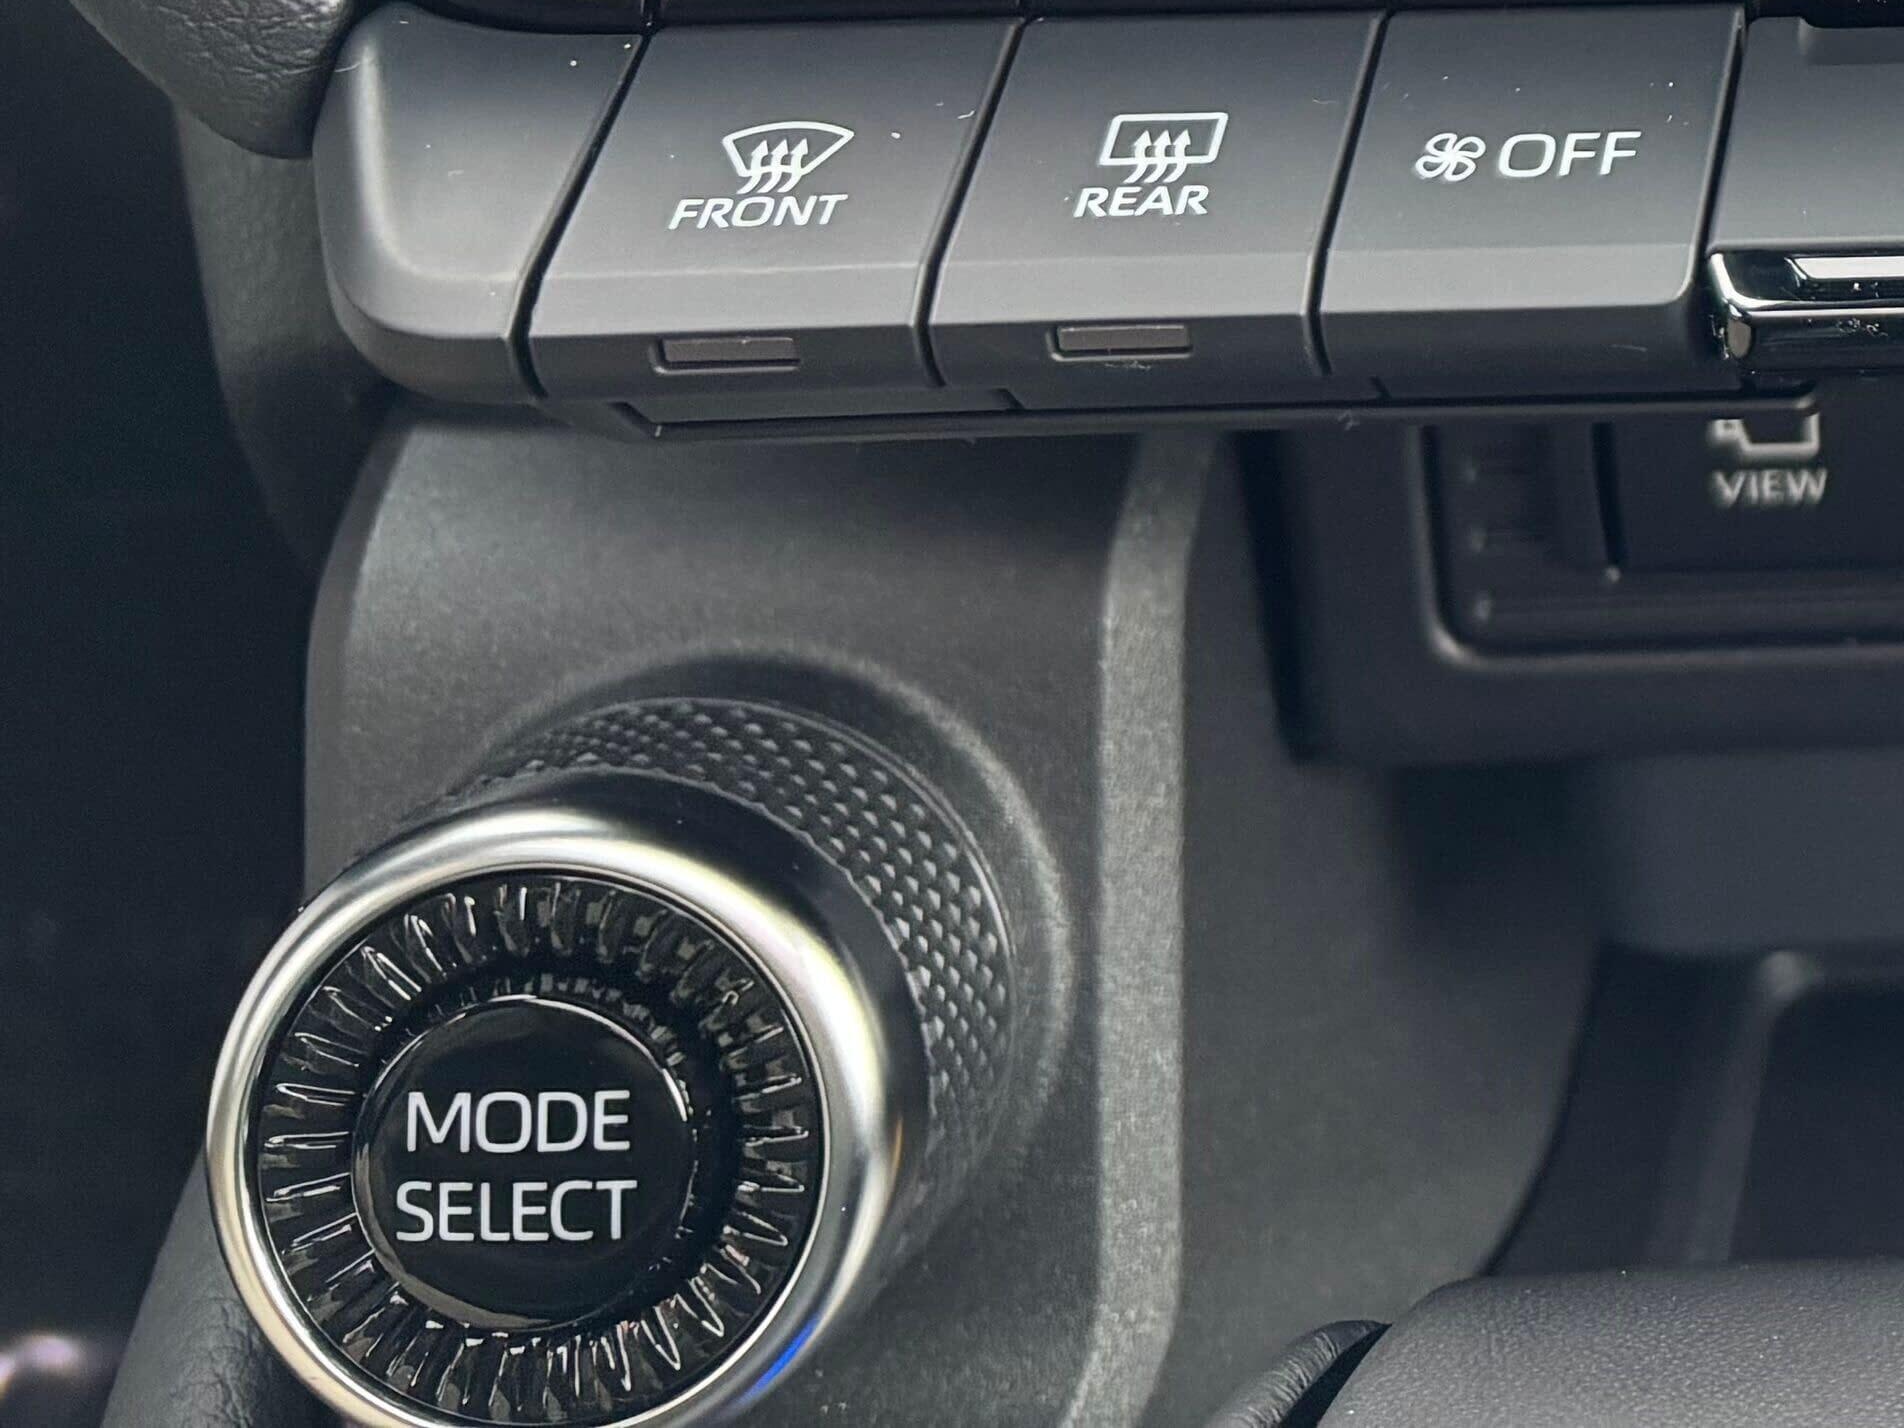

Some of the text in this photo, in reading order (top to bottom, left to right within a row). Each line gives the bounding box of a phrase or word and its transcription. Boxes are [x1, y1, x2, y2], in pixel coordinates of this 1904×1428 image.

[1496, 130, 1643, 180] OFF
[667, 193, 850, 231] FRONT
[1072, 183, 1210, 219] REAR
[1711, 467, 1830, 508] VIEW
[405, 1088, 631, 1154] MODE
[395, 1178, 639, 1243] SELECT
